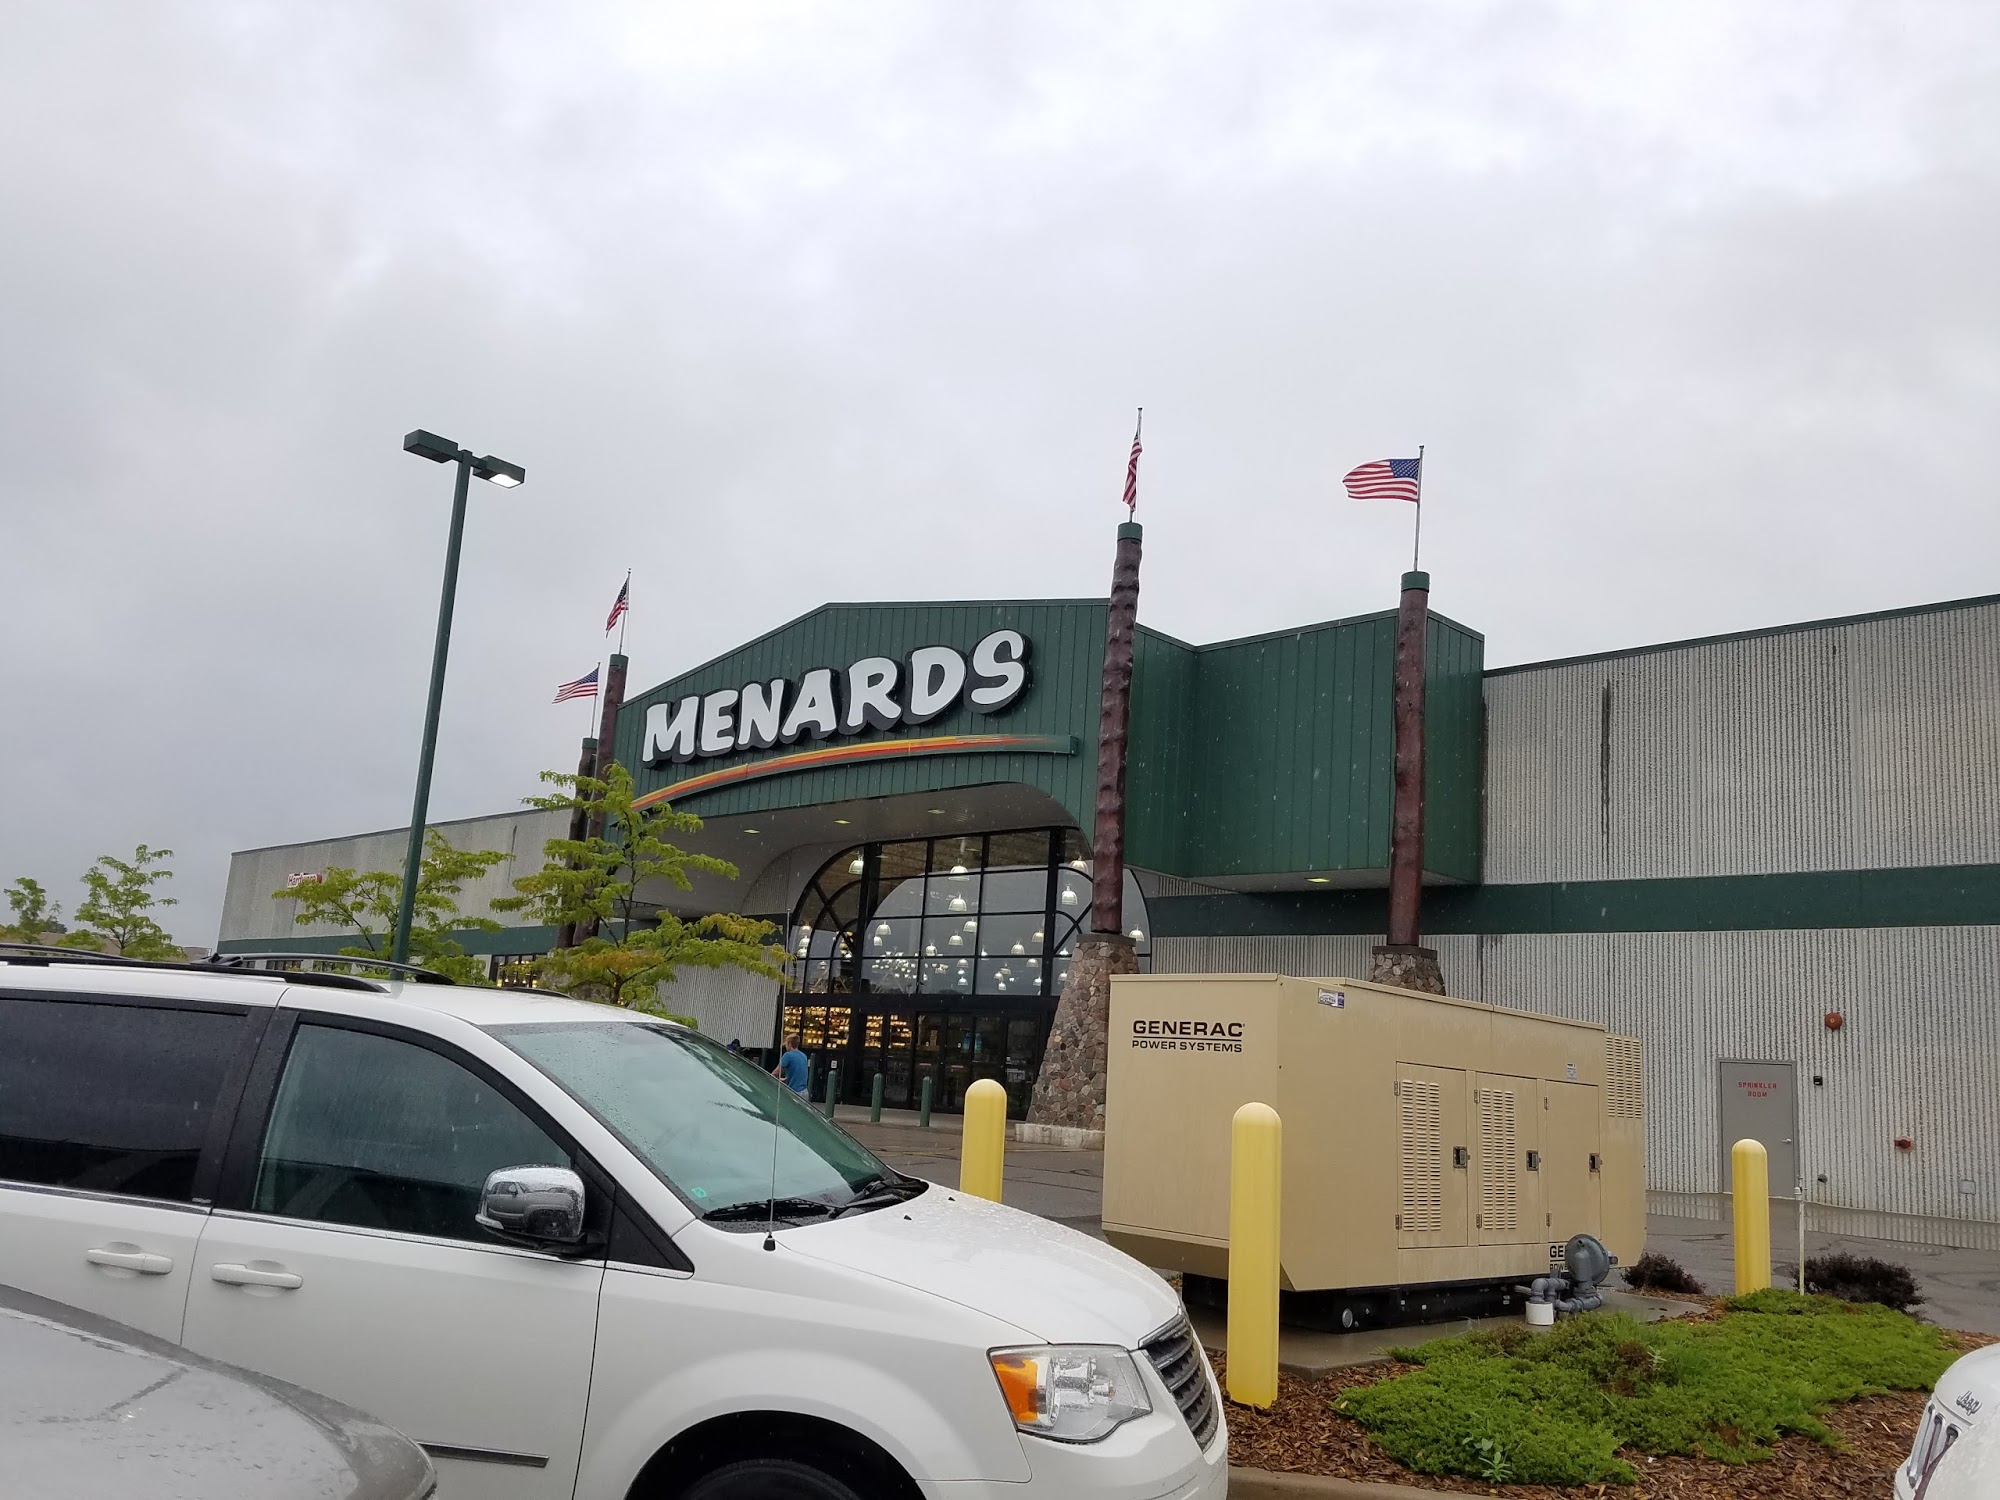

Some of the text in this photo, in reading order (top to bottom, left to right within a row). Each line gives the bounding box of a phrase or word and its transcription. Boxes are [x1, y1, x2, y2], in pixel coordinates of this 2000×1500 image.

[642, 628, 1031, 767] MENARDS
[1133, 1020, 1243, 1037] GENERAC
[1132, 1040, 1242, 1053] POWER SYSTEMS
[1738, 1081, 1777, 1089] SPRINKLER
[1956, 1390, 1982, 1416] Jeep
